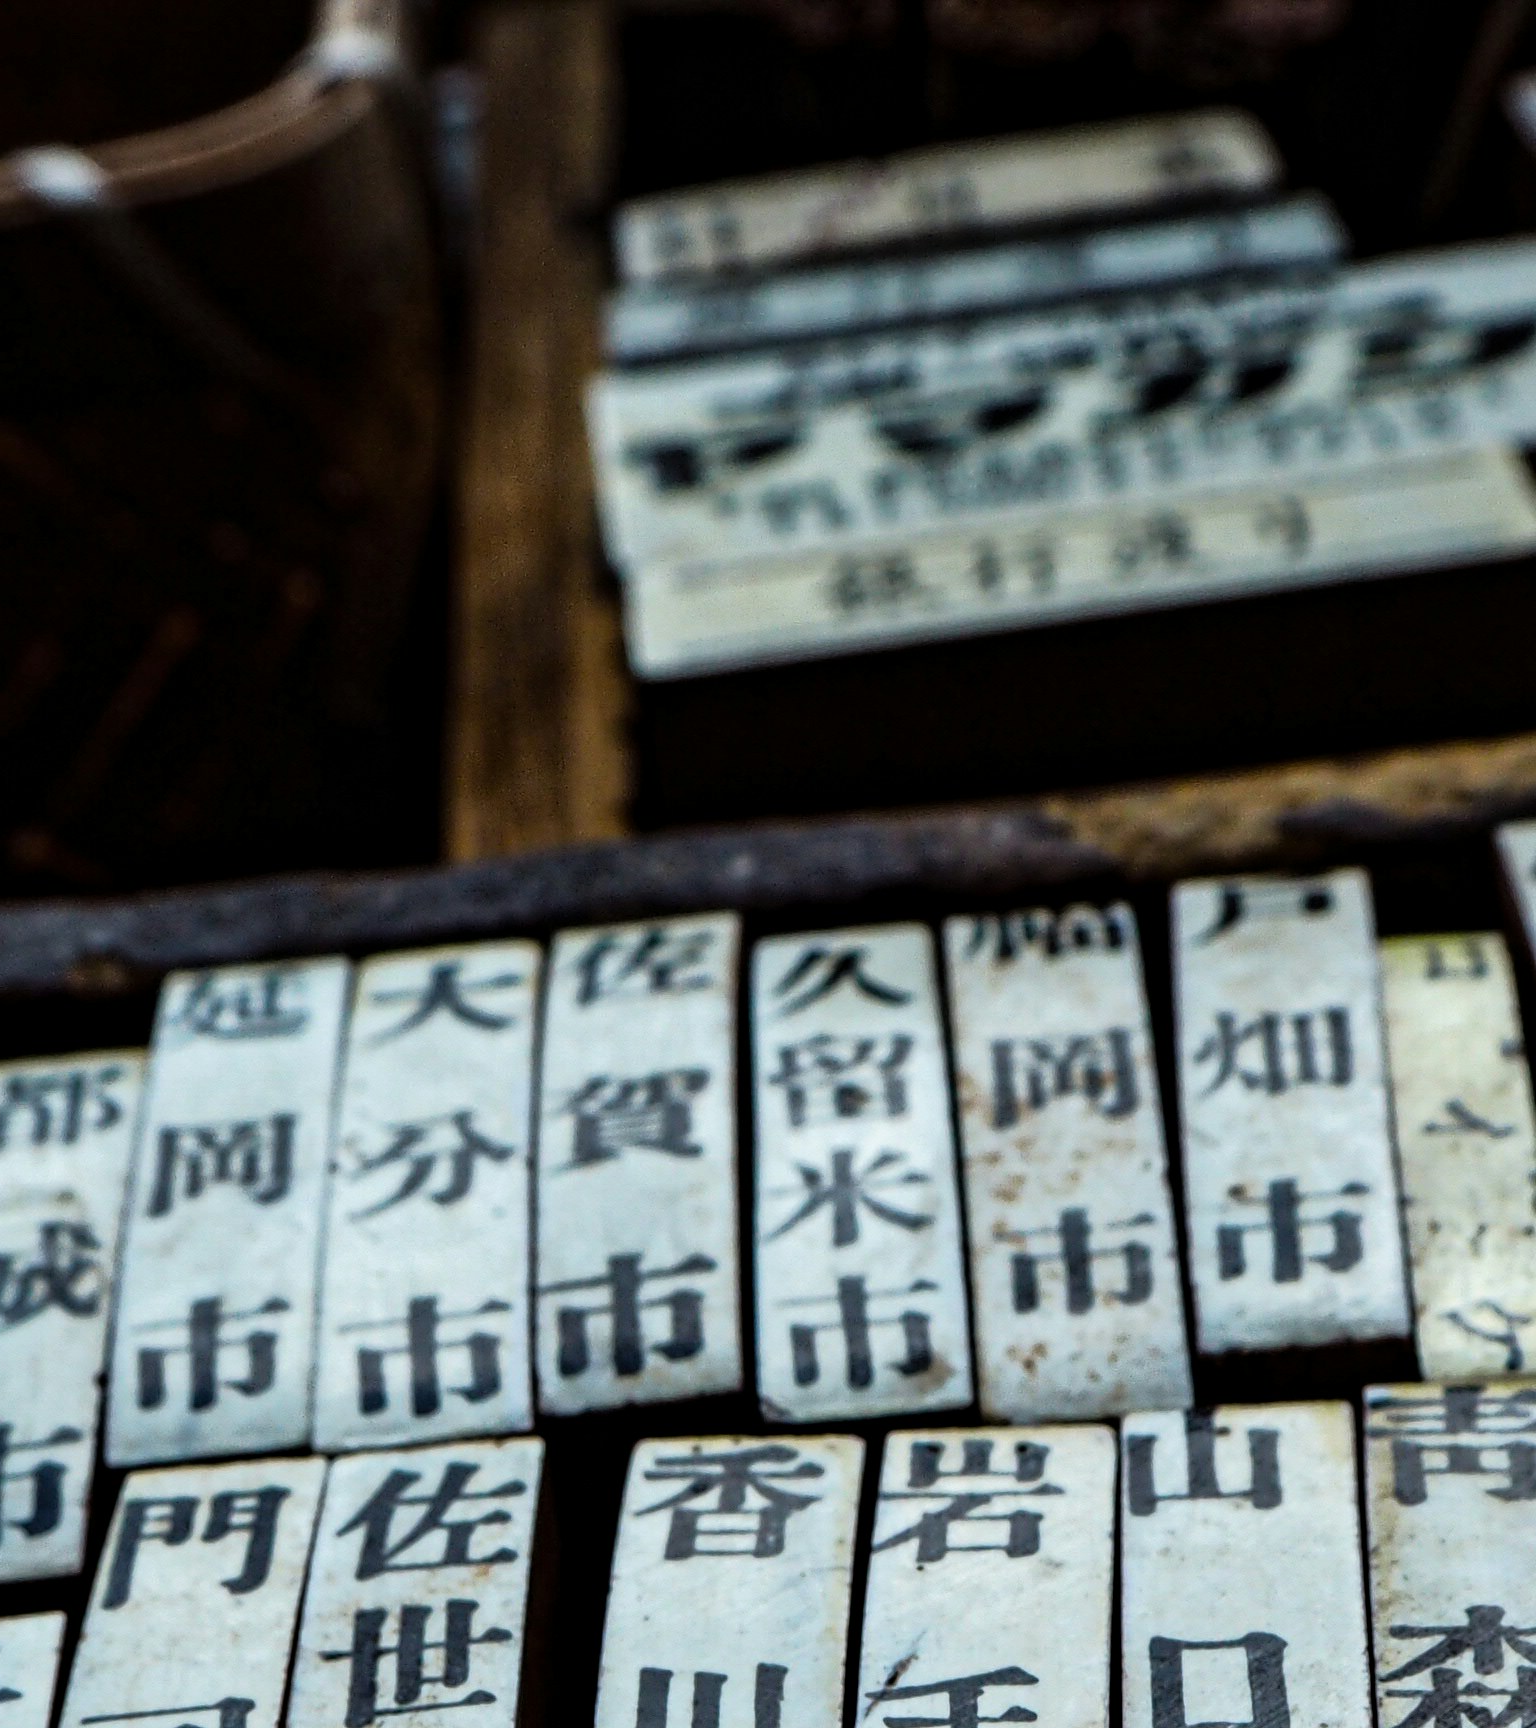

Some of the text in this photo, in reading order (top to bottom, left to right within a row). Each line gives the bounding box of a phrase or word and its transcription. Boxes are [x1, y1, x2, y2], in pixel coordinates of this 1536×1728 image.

[128, 972, 310, 1414] 延岡市
[334, 962, 522, 1418] 大分市
[538, 930, 719, 1378] 佐賀市
[762, 945, 939, 1390] 久留米市
